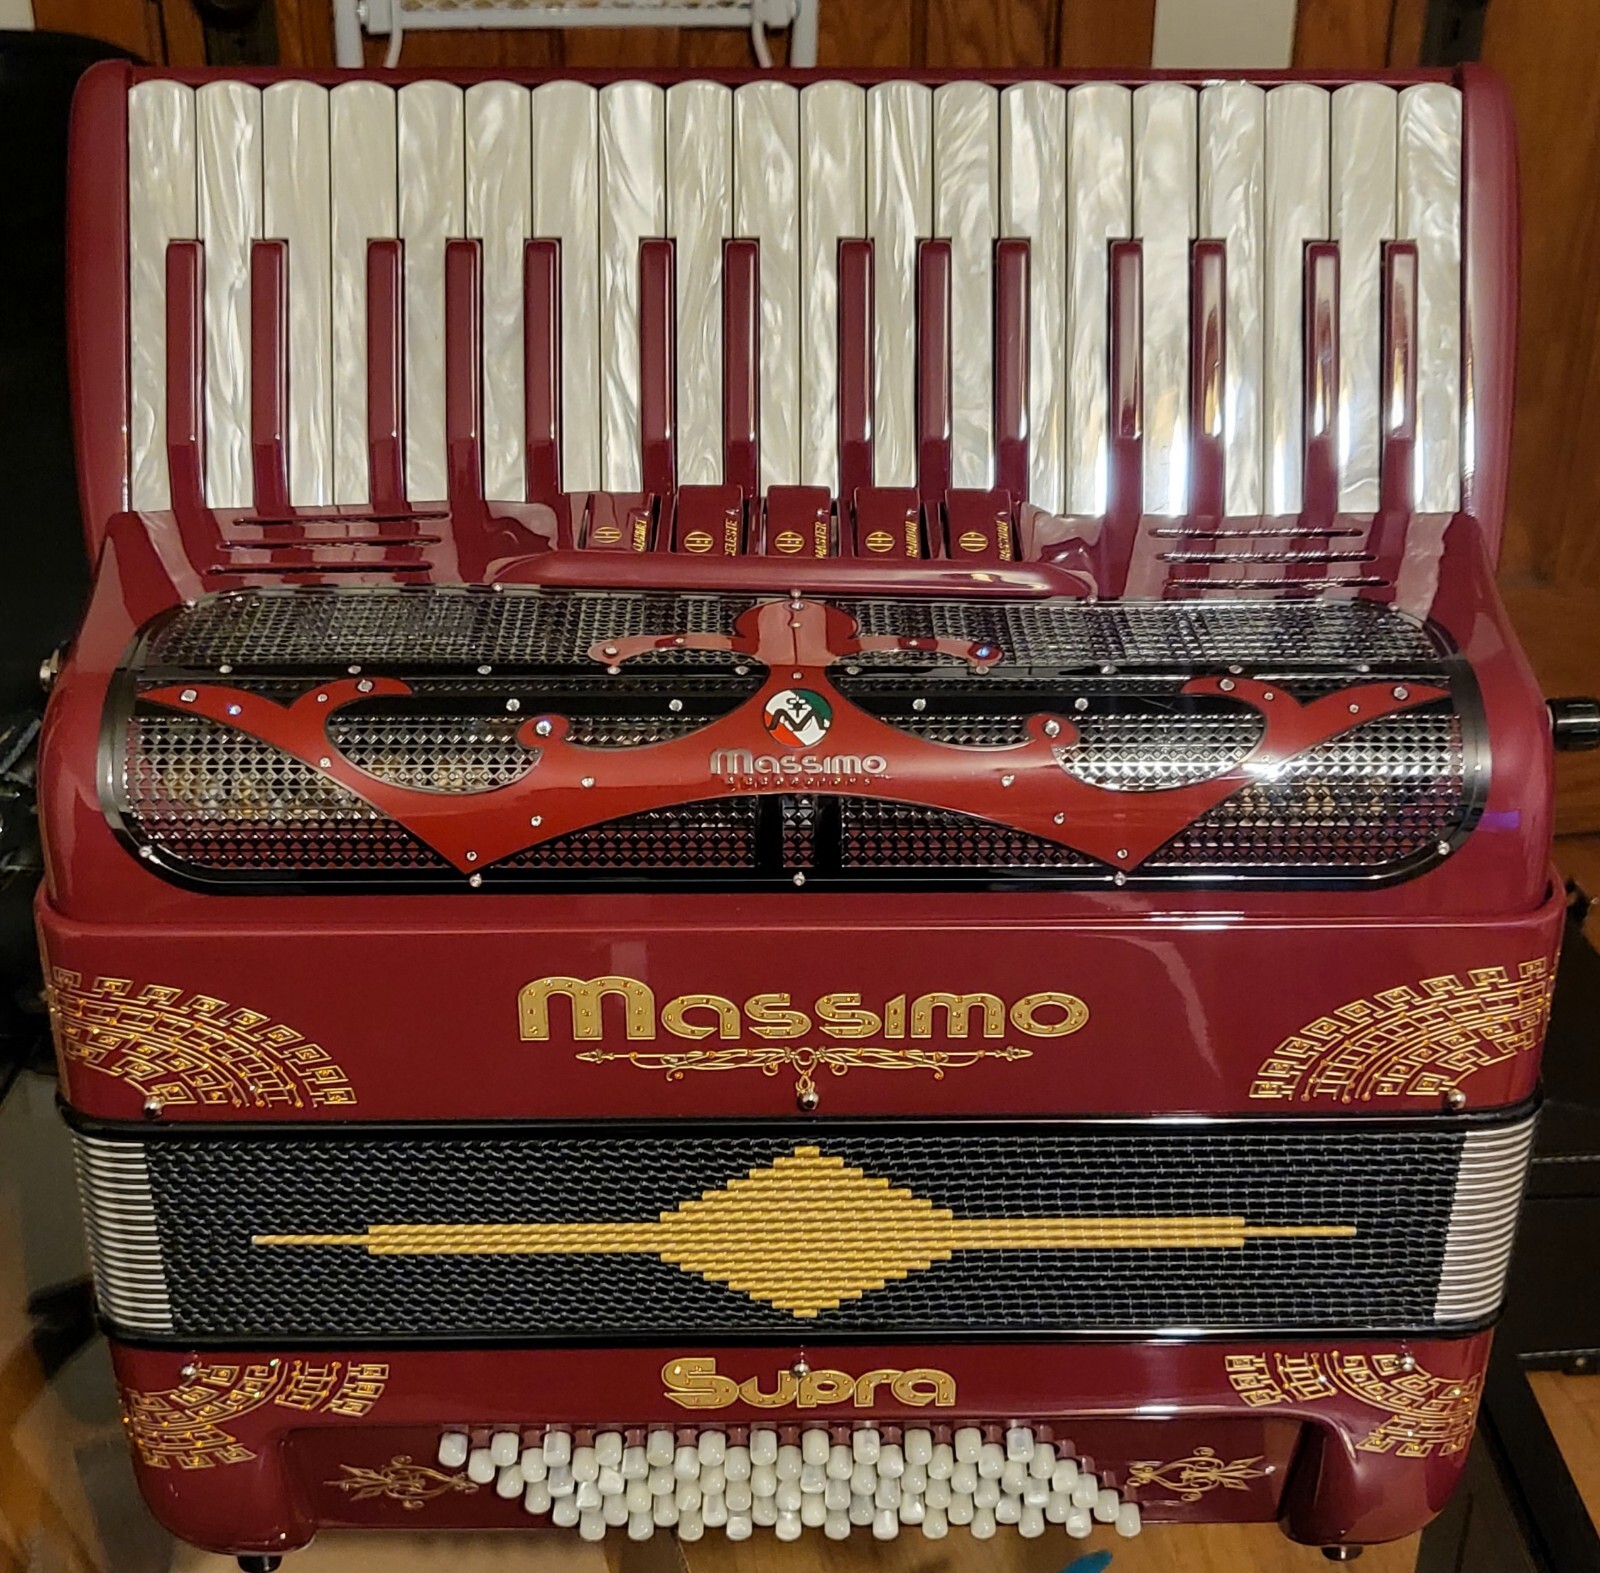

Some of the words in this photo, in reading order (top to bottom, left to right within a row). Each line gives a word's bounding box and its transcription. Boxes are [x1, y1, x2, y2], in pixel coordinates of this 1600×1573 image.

[710, 748, 887, 775] Massimo
[518, 976, 1090, 1041] Massimo
[661, 1357, 956, 1409] Supra
